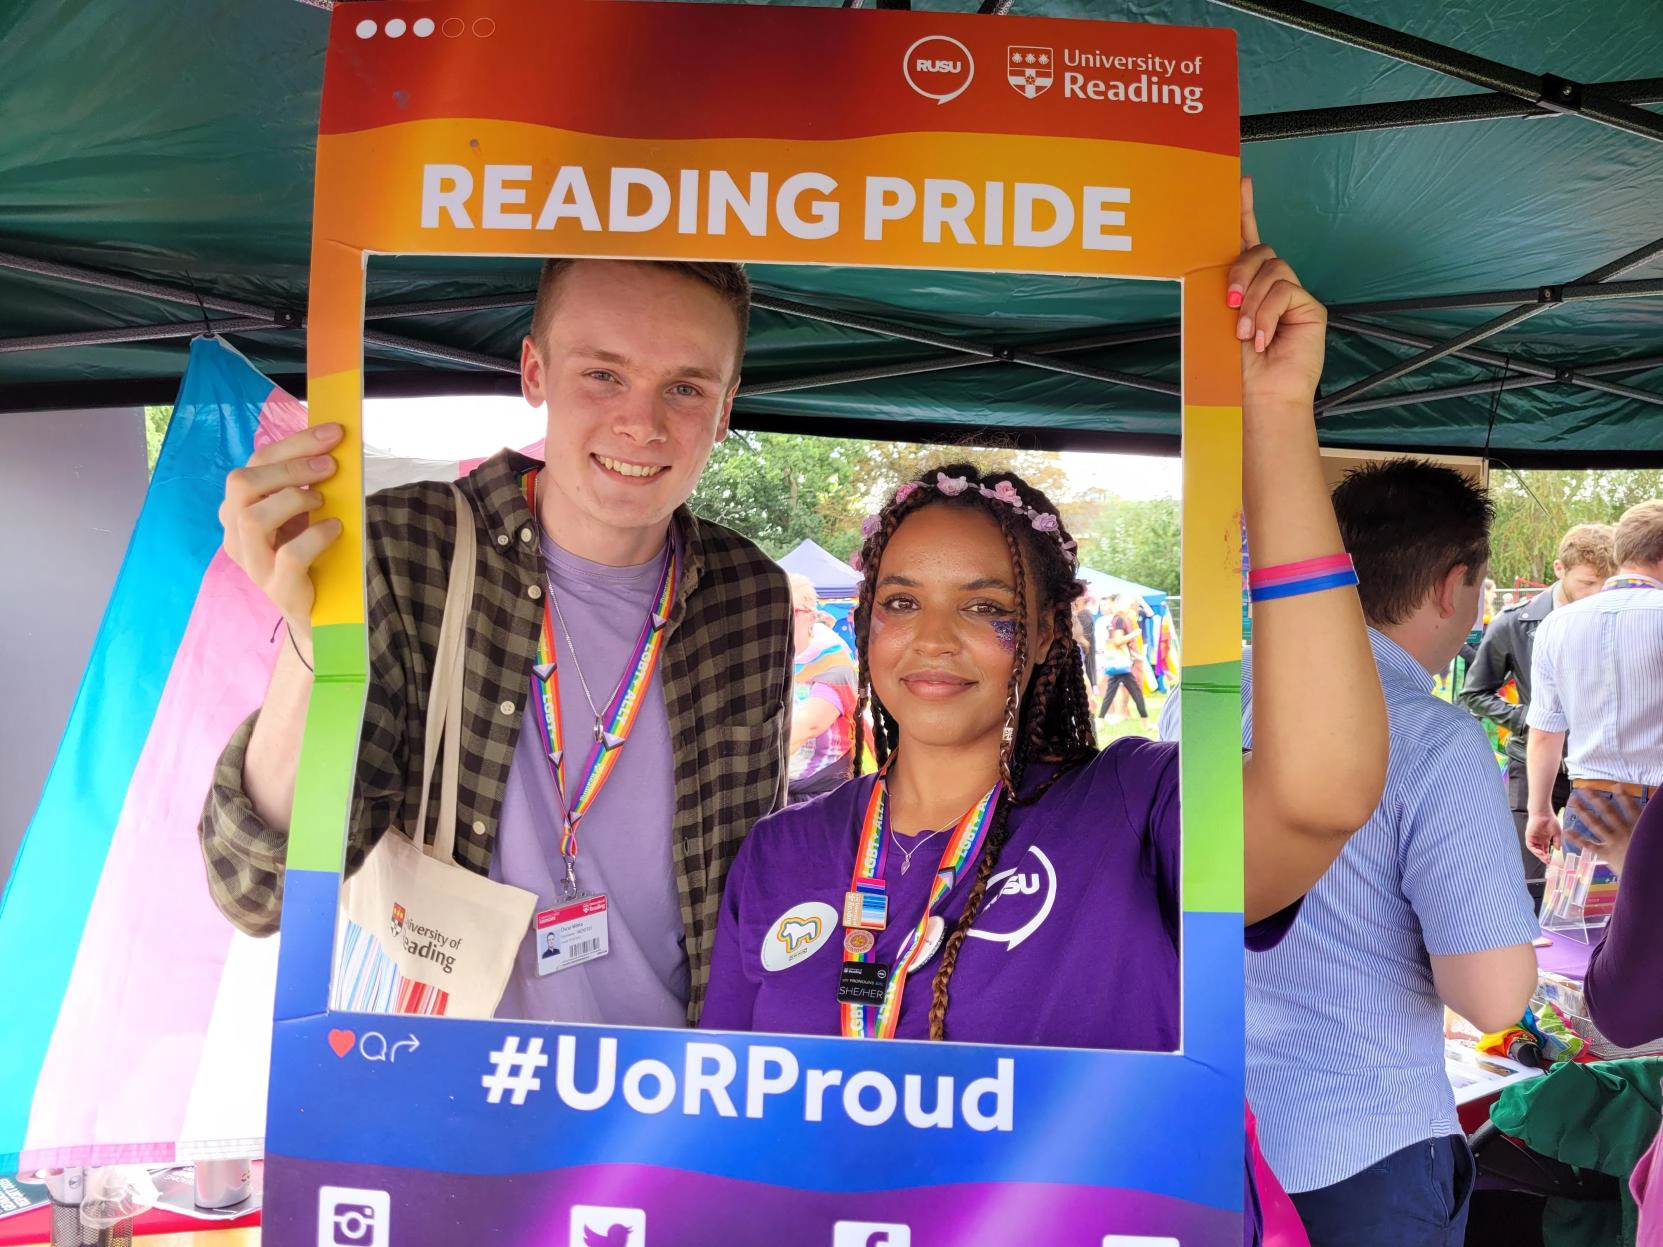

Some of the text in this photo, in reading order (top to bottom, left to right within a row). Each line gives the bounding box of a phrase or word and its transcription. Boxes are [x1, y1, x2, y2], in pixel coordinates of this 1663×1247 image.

[916, 58, 962, 74] RUSU
[1063, 48, 1203, 78] University of
[1063, 71, 1204, 114] Reading
[420, 163, 1133, 252] READING PRIDE
[616, 689, 637, 726] ALLY
[407, 918, 463, 950] iversity of
[403, 935, 456, 974] eading
[839, 986, 884, 999] SHE/HER
[481, 1035, 1015, 1132] #UoRProud
